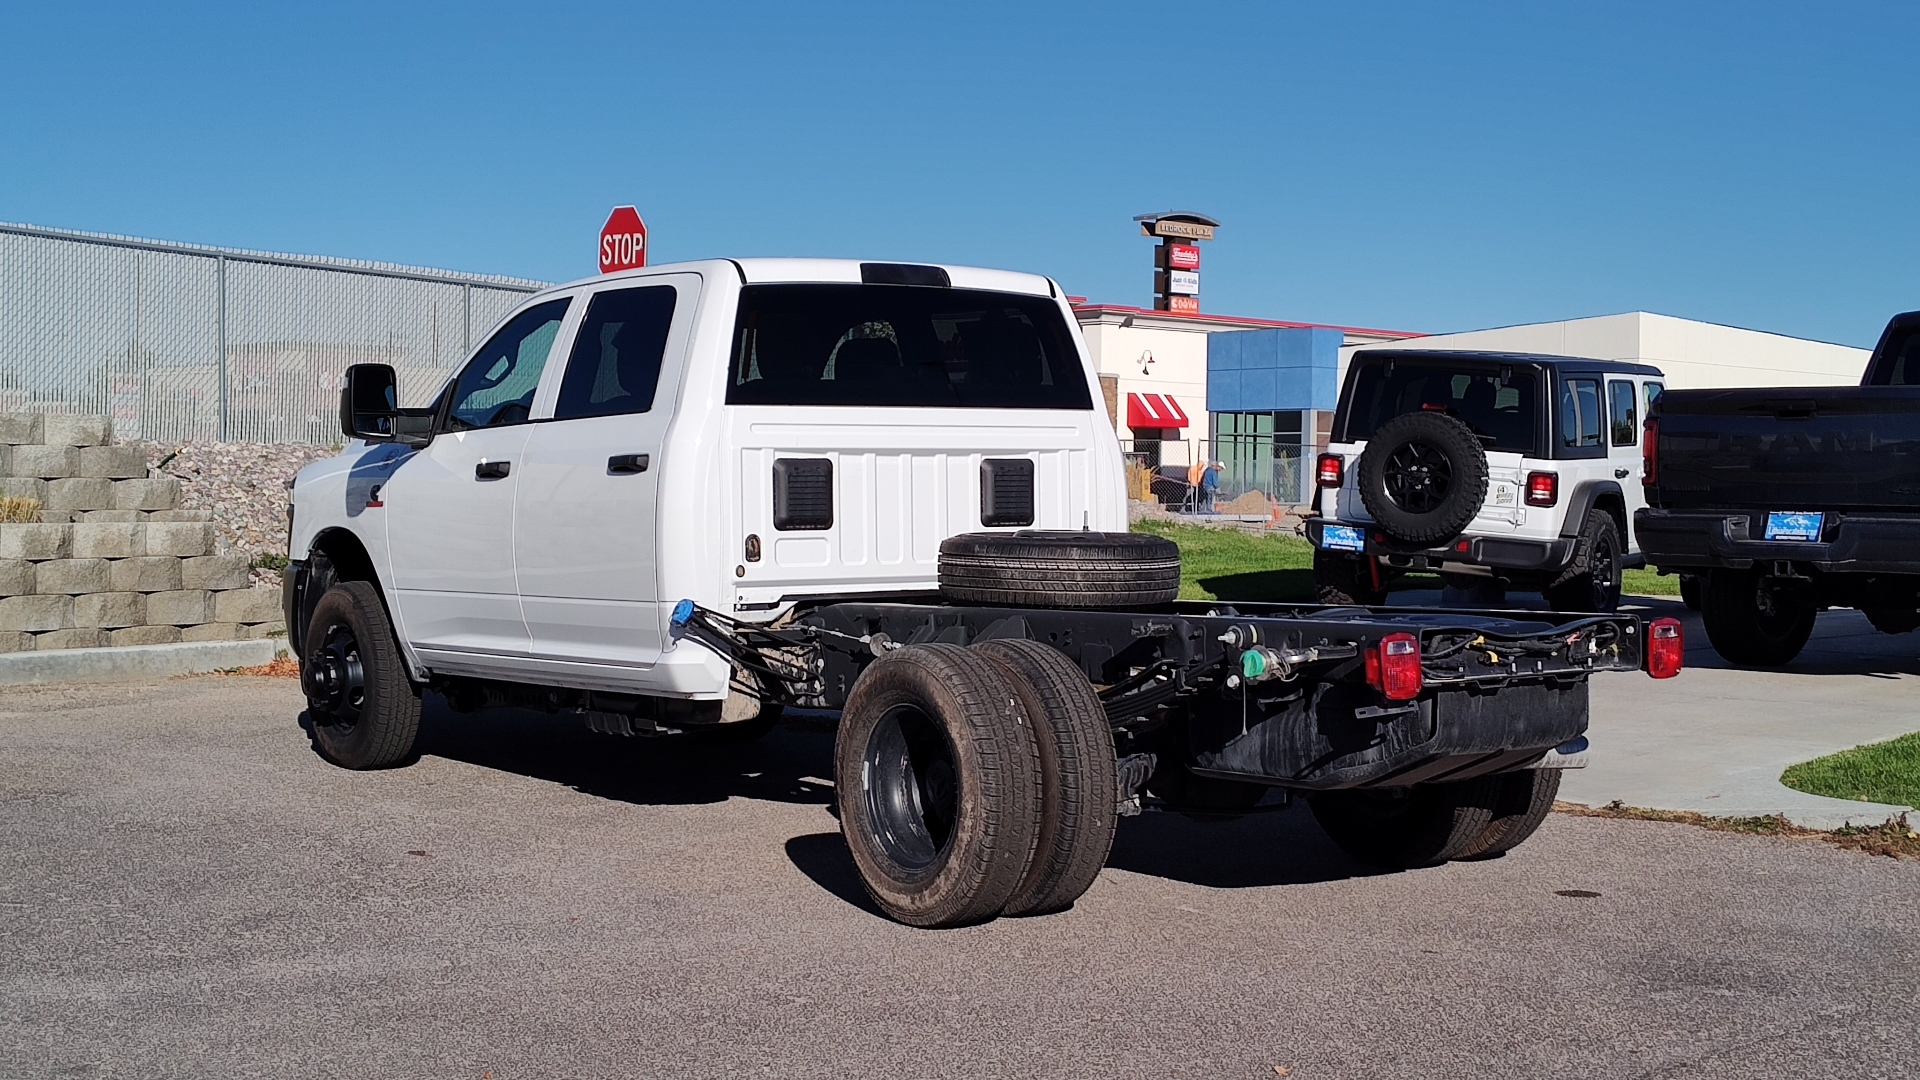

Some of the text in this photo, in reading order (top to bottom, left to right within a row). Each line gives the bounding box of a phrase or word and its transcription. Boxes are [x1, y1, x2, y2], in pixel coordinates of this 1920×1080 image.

[1161, 223, 1212, 236] BEDROCK PLAZA
[602, 233, 643, 265] STOP
[1718, 431, 1873, 453] RAM
